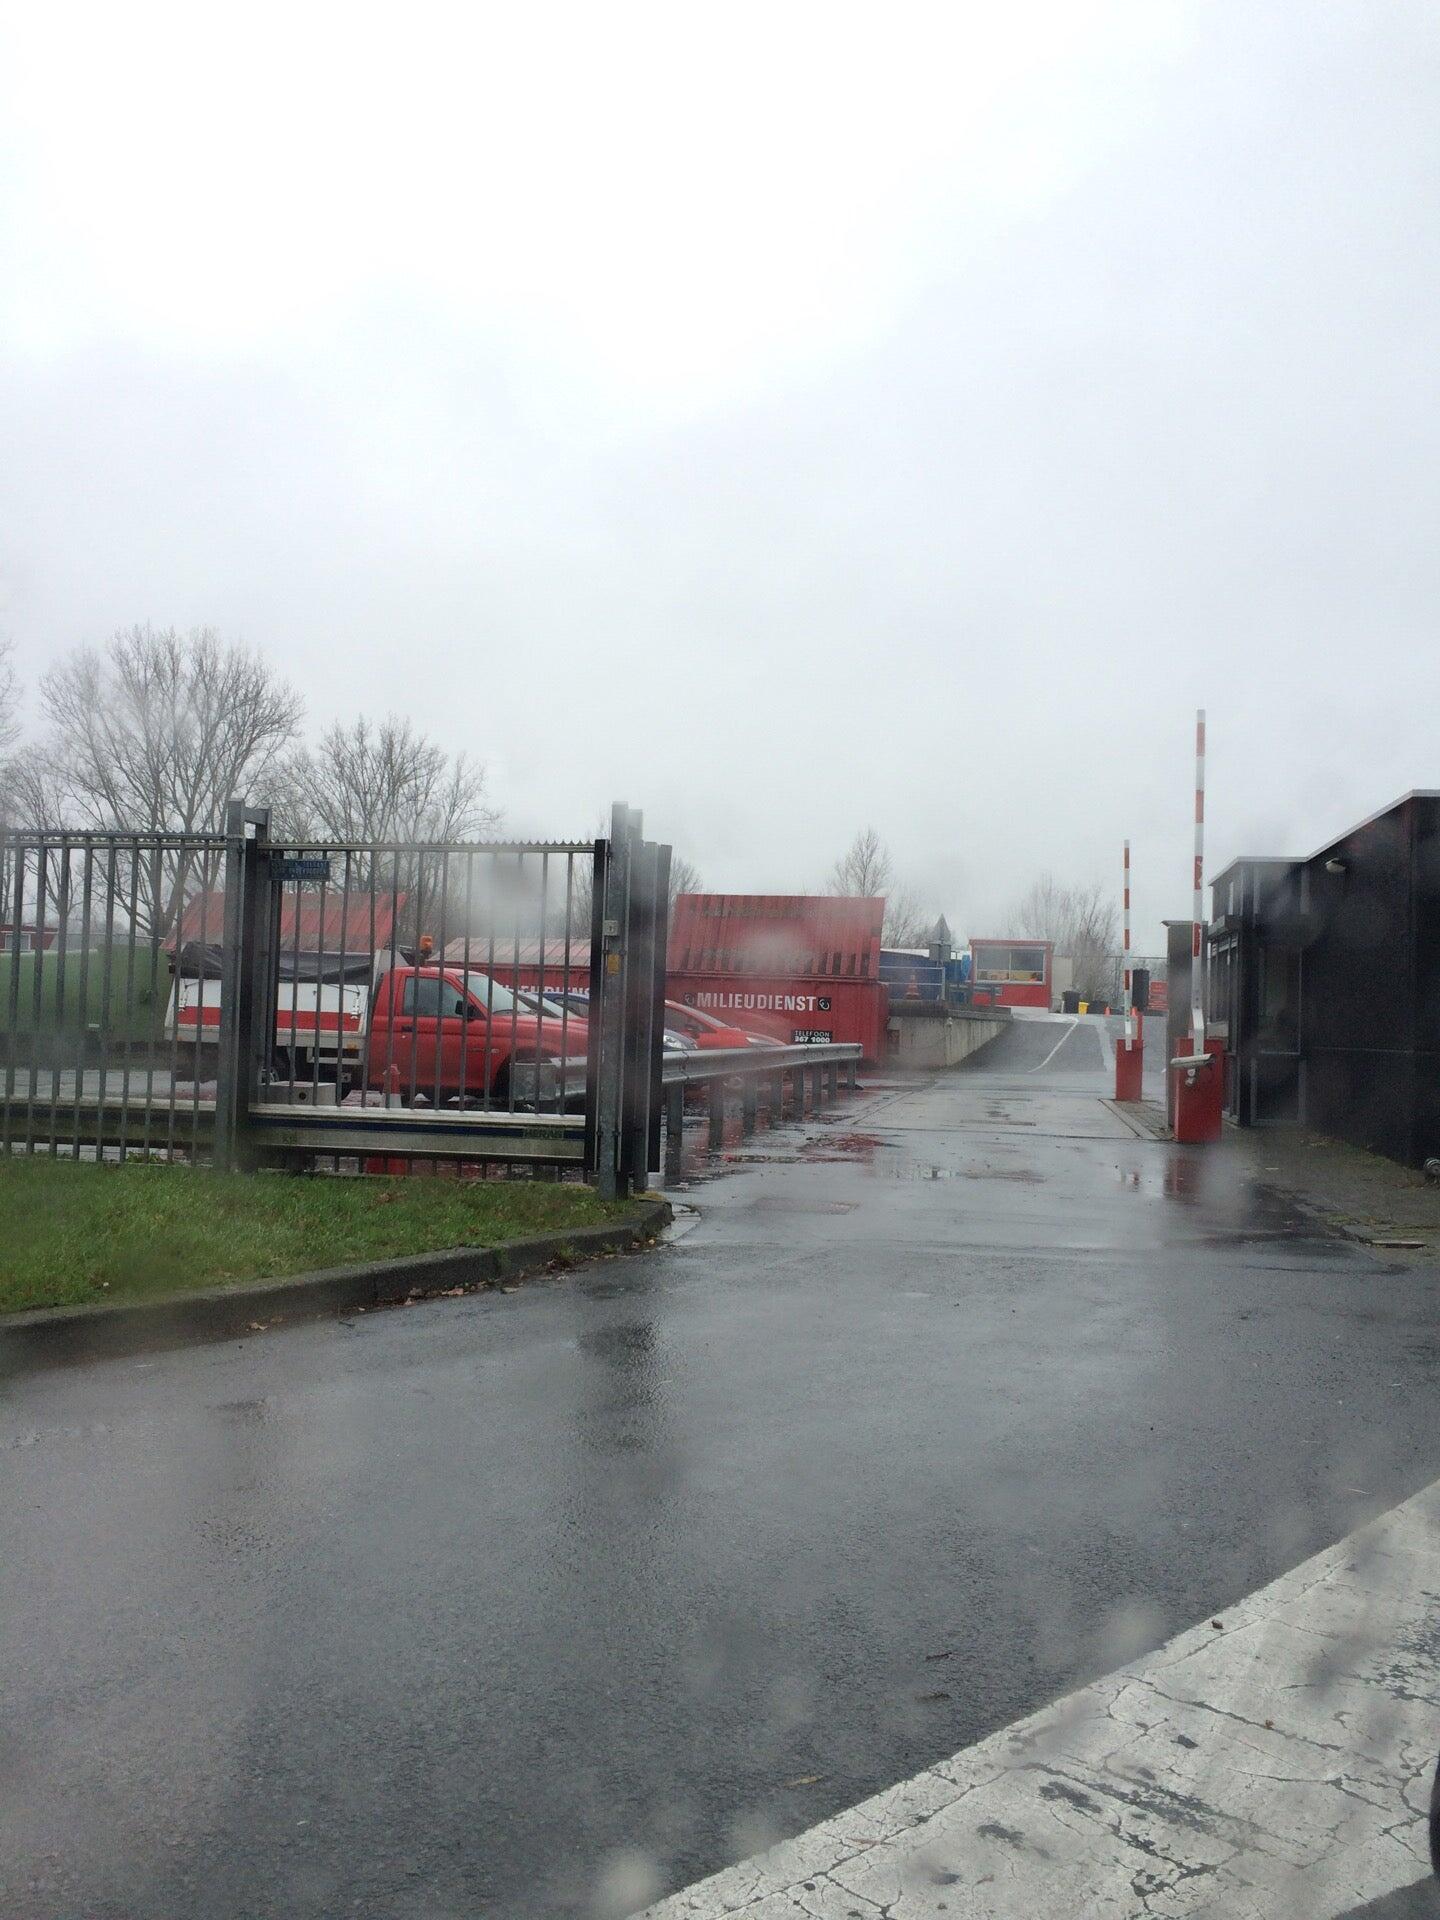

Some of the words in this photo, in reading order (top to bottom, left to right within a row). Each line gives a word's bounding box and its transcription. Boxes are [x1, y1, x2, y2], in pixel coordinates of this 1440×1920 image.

[697, 992, 816, 1011] MILIEUDIENST
[795, 1030, 830, 1038] TELEFOON
[811, 1036, 830, 1044] 1000
